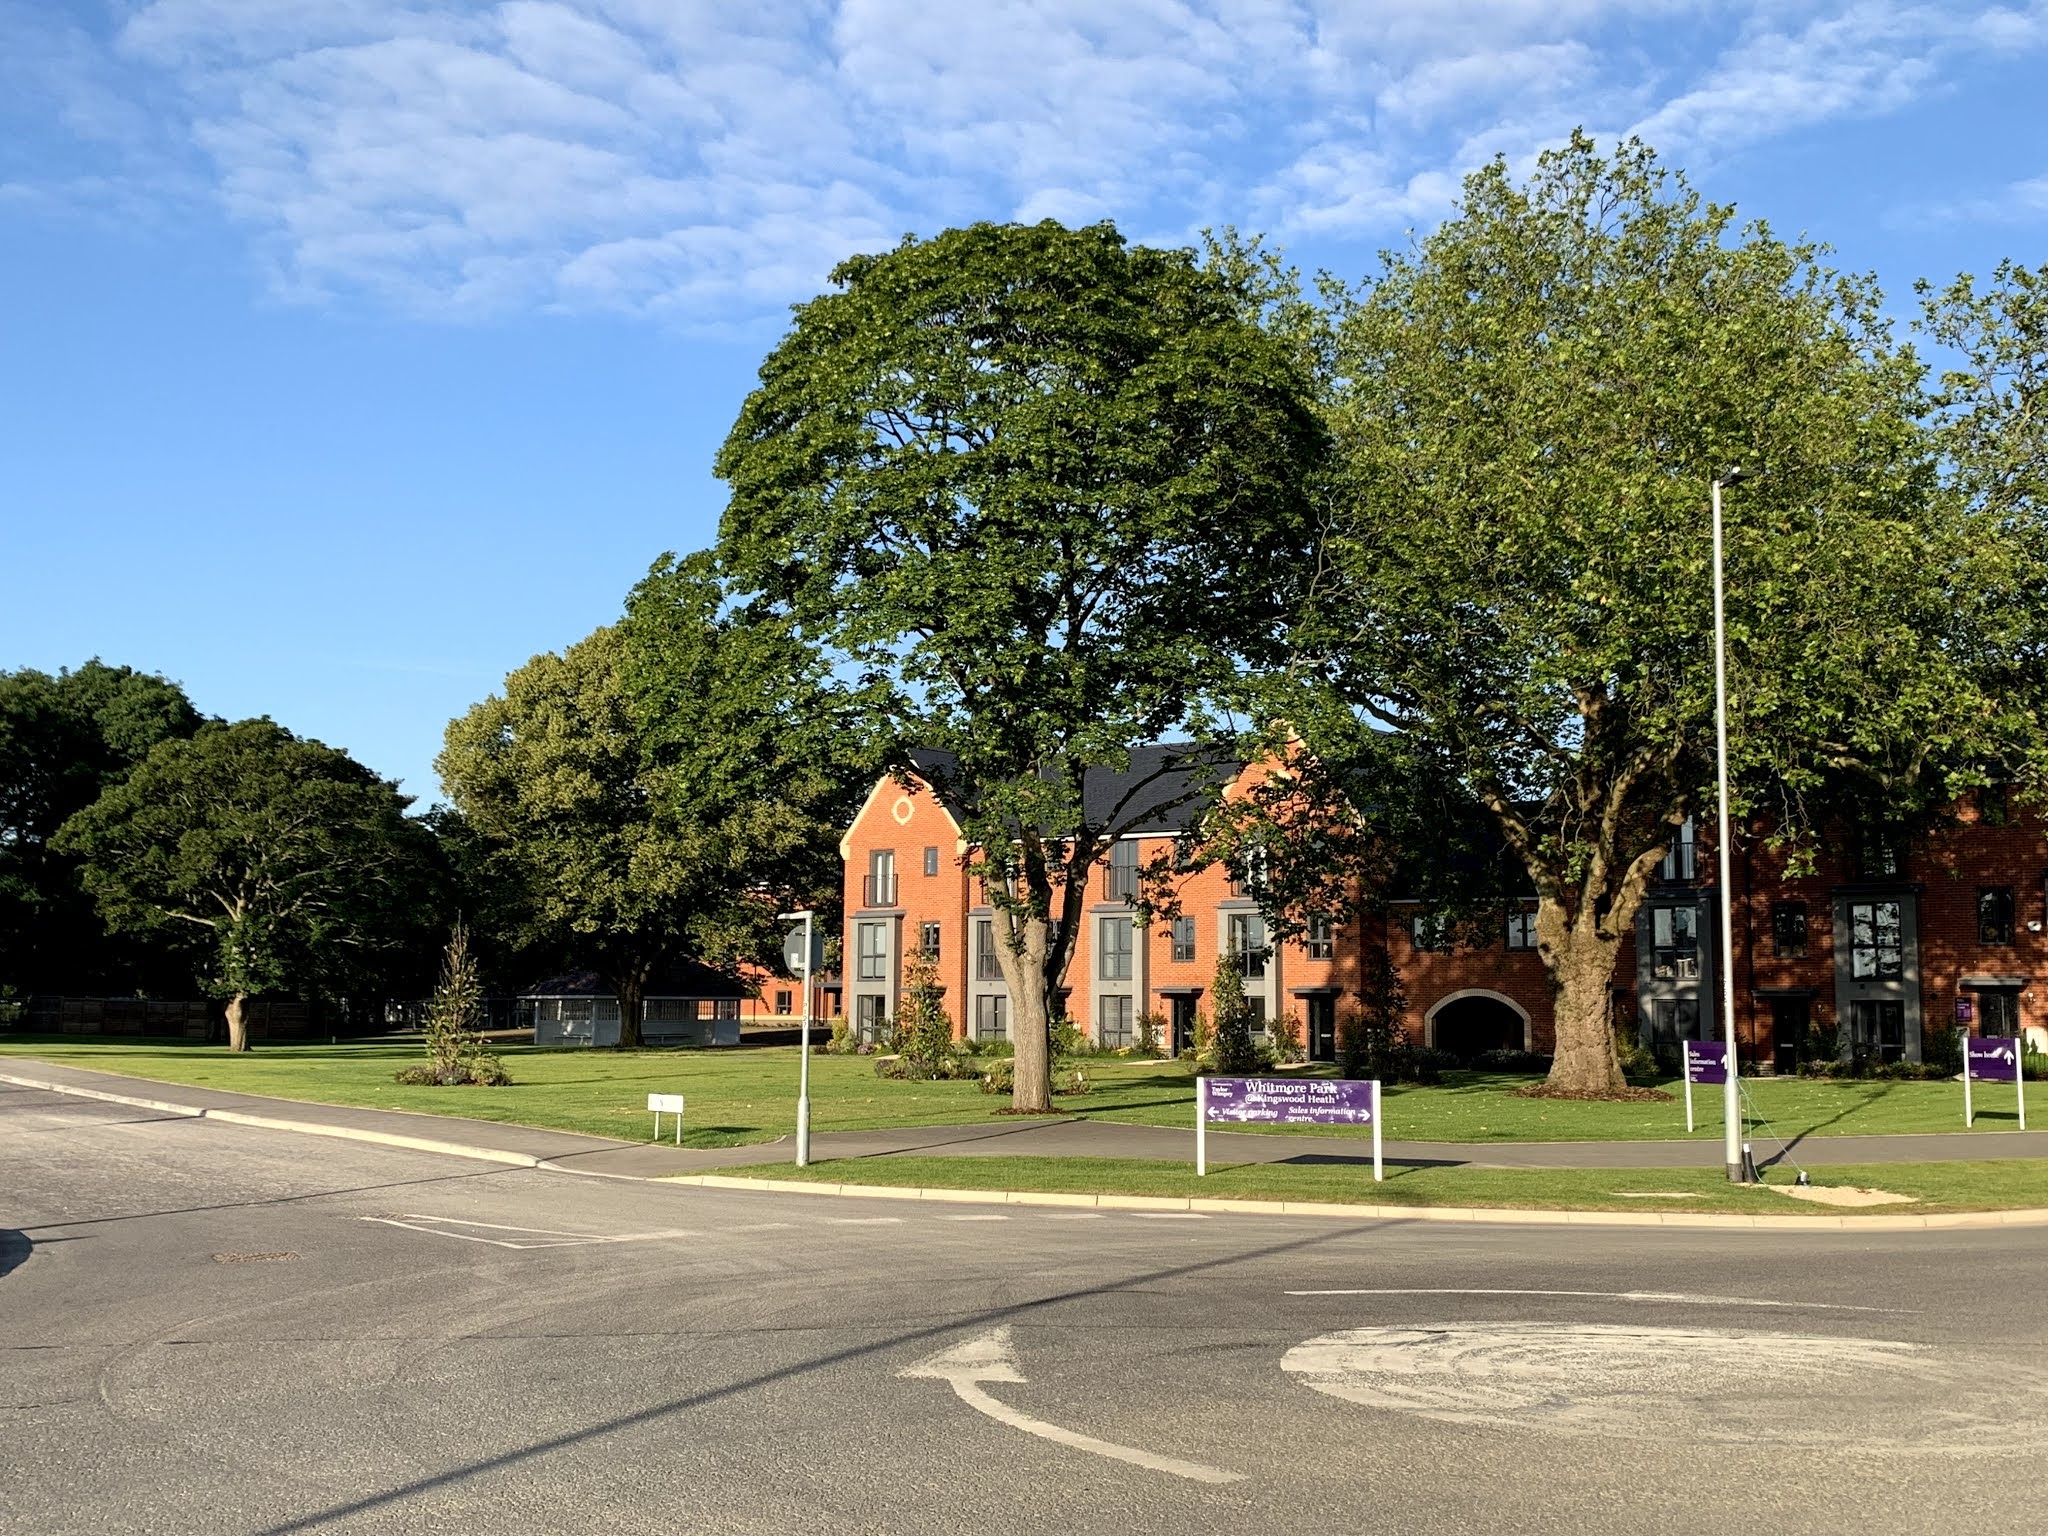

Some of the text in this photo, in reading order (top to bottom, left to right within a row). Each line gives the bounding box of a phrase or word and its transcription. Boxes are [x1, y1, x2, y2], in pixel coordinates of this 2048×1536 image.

[1245, 1081, 1338, 1094] Whitmore Park
[1307, 1094, 1336, 1104] Heath
[1247, 1108, 1279, 1119] parking
[1288, 1106, 1356, 1116] Sales information
